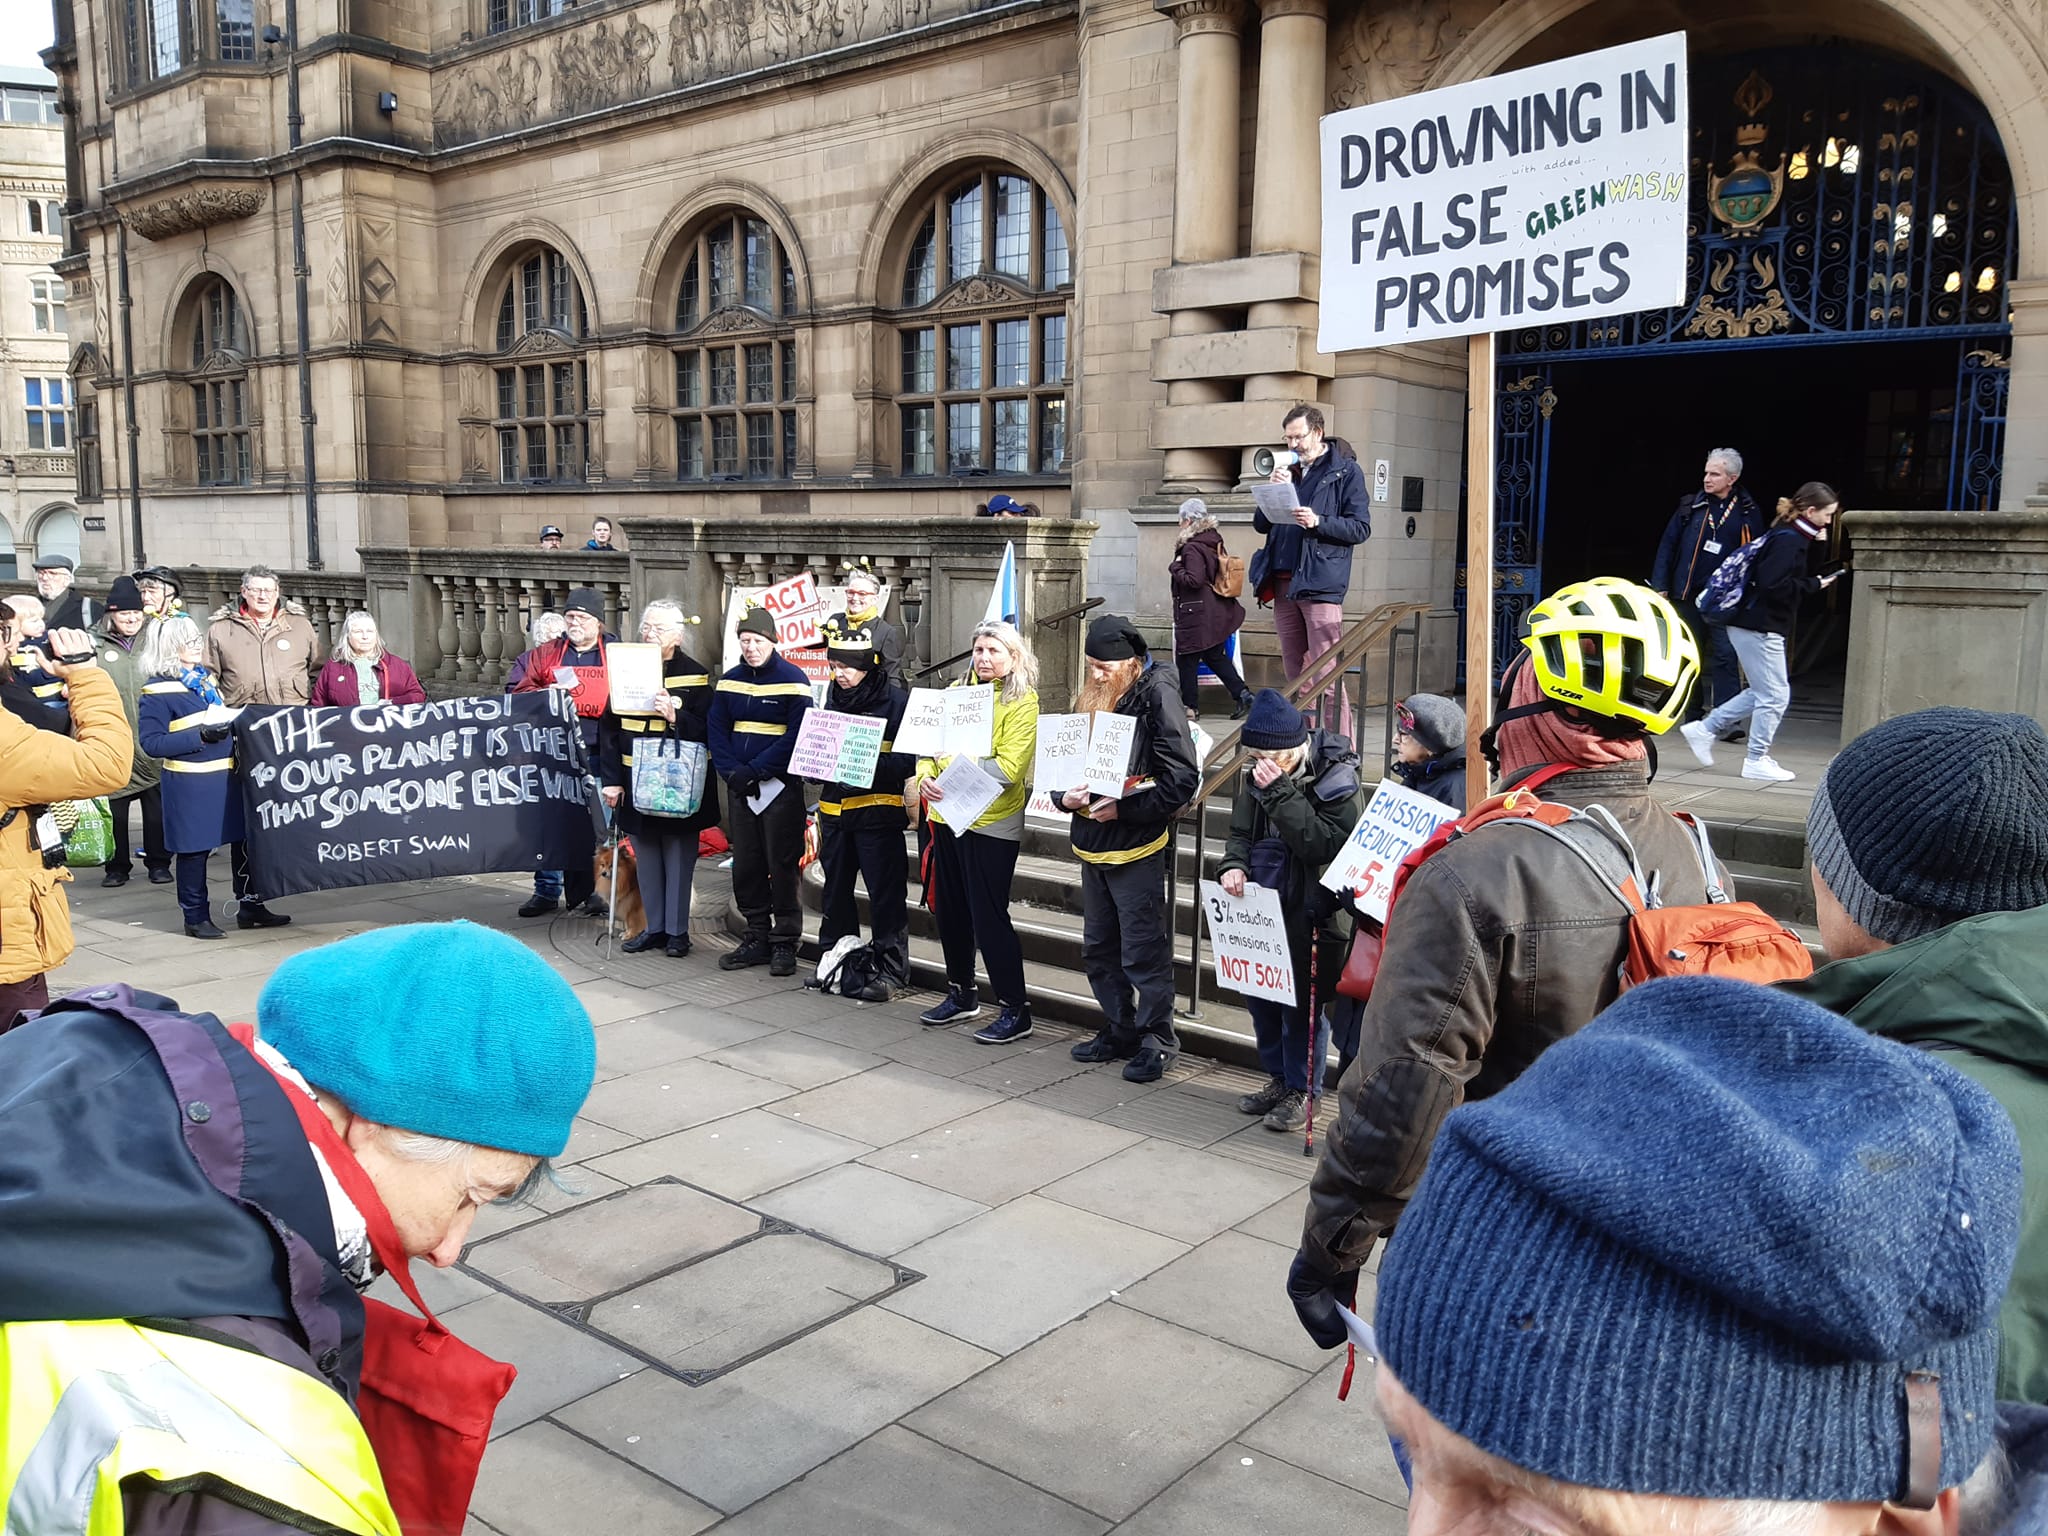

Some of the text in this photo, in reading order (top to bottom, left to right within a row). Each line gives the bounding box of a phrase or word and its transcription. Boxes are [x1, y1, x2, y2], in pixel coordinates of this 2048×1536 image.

[1340, 62, 1676, 189] DROWNING IN
[1351, 185, 1508, 265] FALSE
[1373, 241, 1631, 332] PROMISES
[765, 579, 807, 613] ACT
[776, 617, 816, 644] NOW
[784, 650, 828, 660] Privatisat
[969, 688, 991, 699] 2022
[1552, 685, 1583, 701] LAZER
[249, 706, 342, 755] THE
[350, 693, 512, 733] GREATEST
[1064, 718, 1086, 728] 2023
[1111, 720, 1131, 733] 2024
[250, 762, 277, 788] TO
[280, 754, 356, 793] OUR
[362, 726, 479, 775] PLANET
[486, 726, 508, 758] IS
[513, 723, 567, 760] THE
[1096, 756, 1114, 768] AND
[1084, 767, 1122, 784] COUNTING
[256, 794, 317, 830] THAT
[319, 770, 464, 829] SOMEONE
[471, 765, 539, 806] ELSE
[540, 767, 586, 806] WILL
[1370, 791, 1452, 838] EMISSION
[317, 833, 470, 864] ROBERT SWAN
[1352, 820, 1414, 867] REDUCTI
[1344, 861, 1391, 902] IN 5 YEA
[1210, 898, 1275, 929] 3% reduction
[1217, 928, 1282, 956] in emissions is
[1220, 955, 1250, 983] NOT
